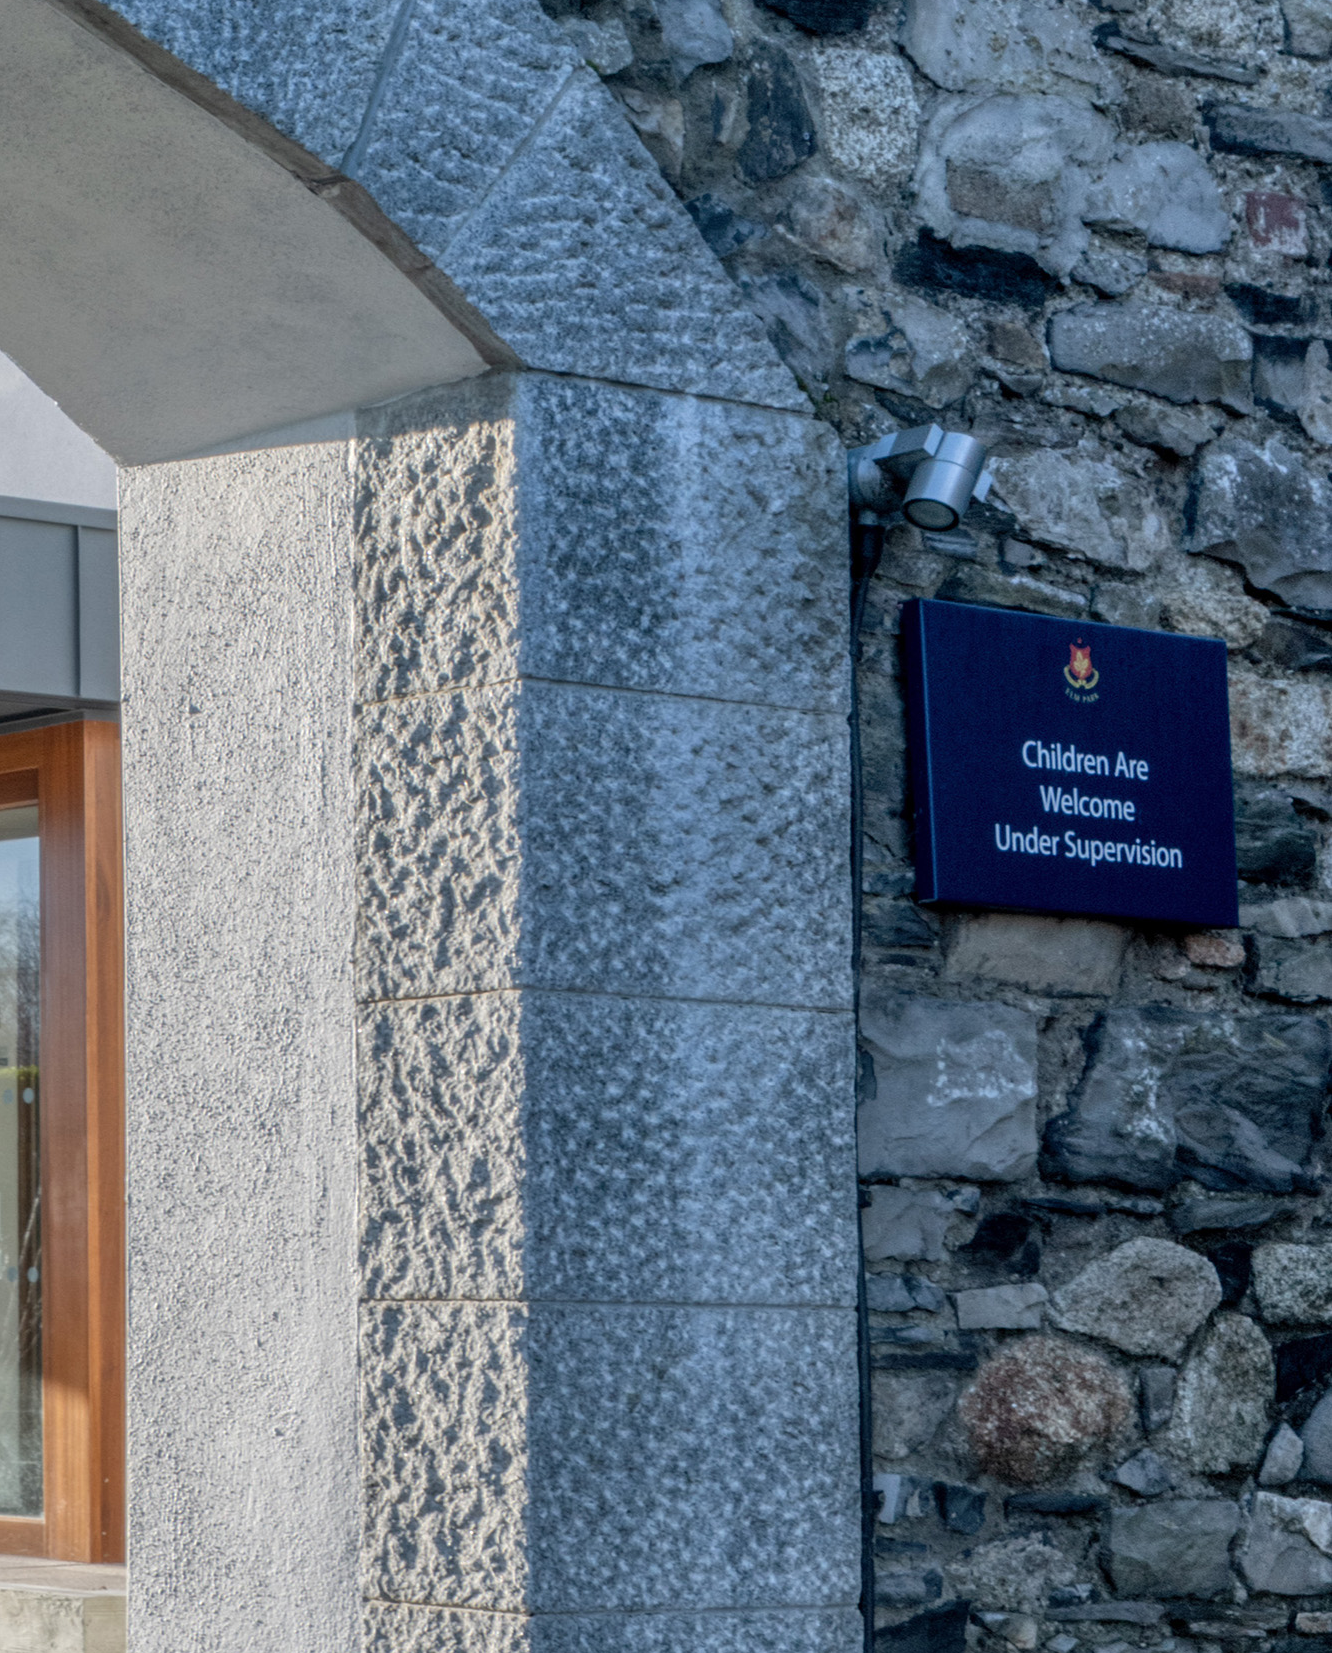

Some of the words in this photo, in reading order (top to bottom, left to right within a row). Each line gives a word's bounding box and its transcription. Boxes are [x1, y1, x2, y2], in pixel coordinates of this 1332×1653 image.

[1022, 740, 1109, 776] Children
[1114, 751, 1149, 780] Are
[1039, 784, 1136, 821] Welcome
[995, 823, 1060, 856] Under
[1064, 830, 1183, 868] Supervision
